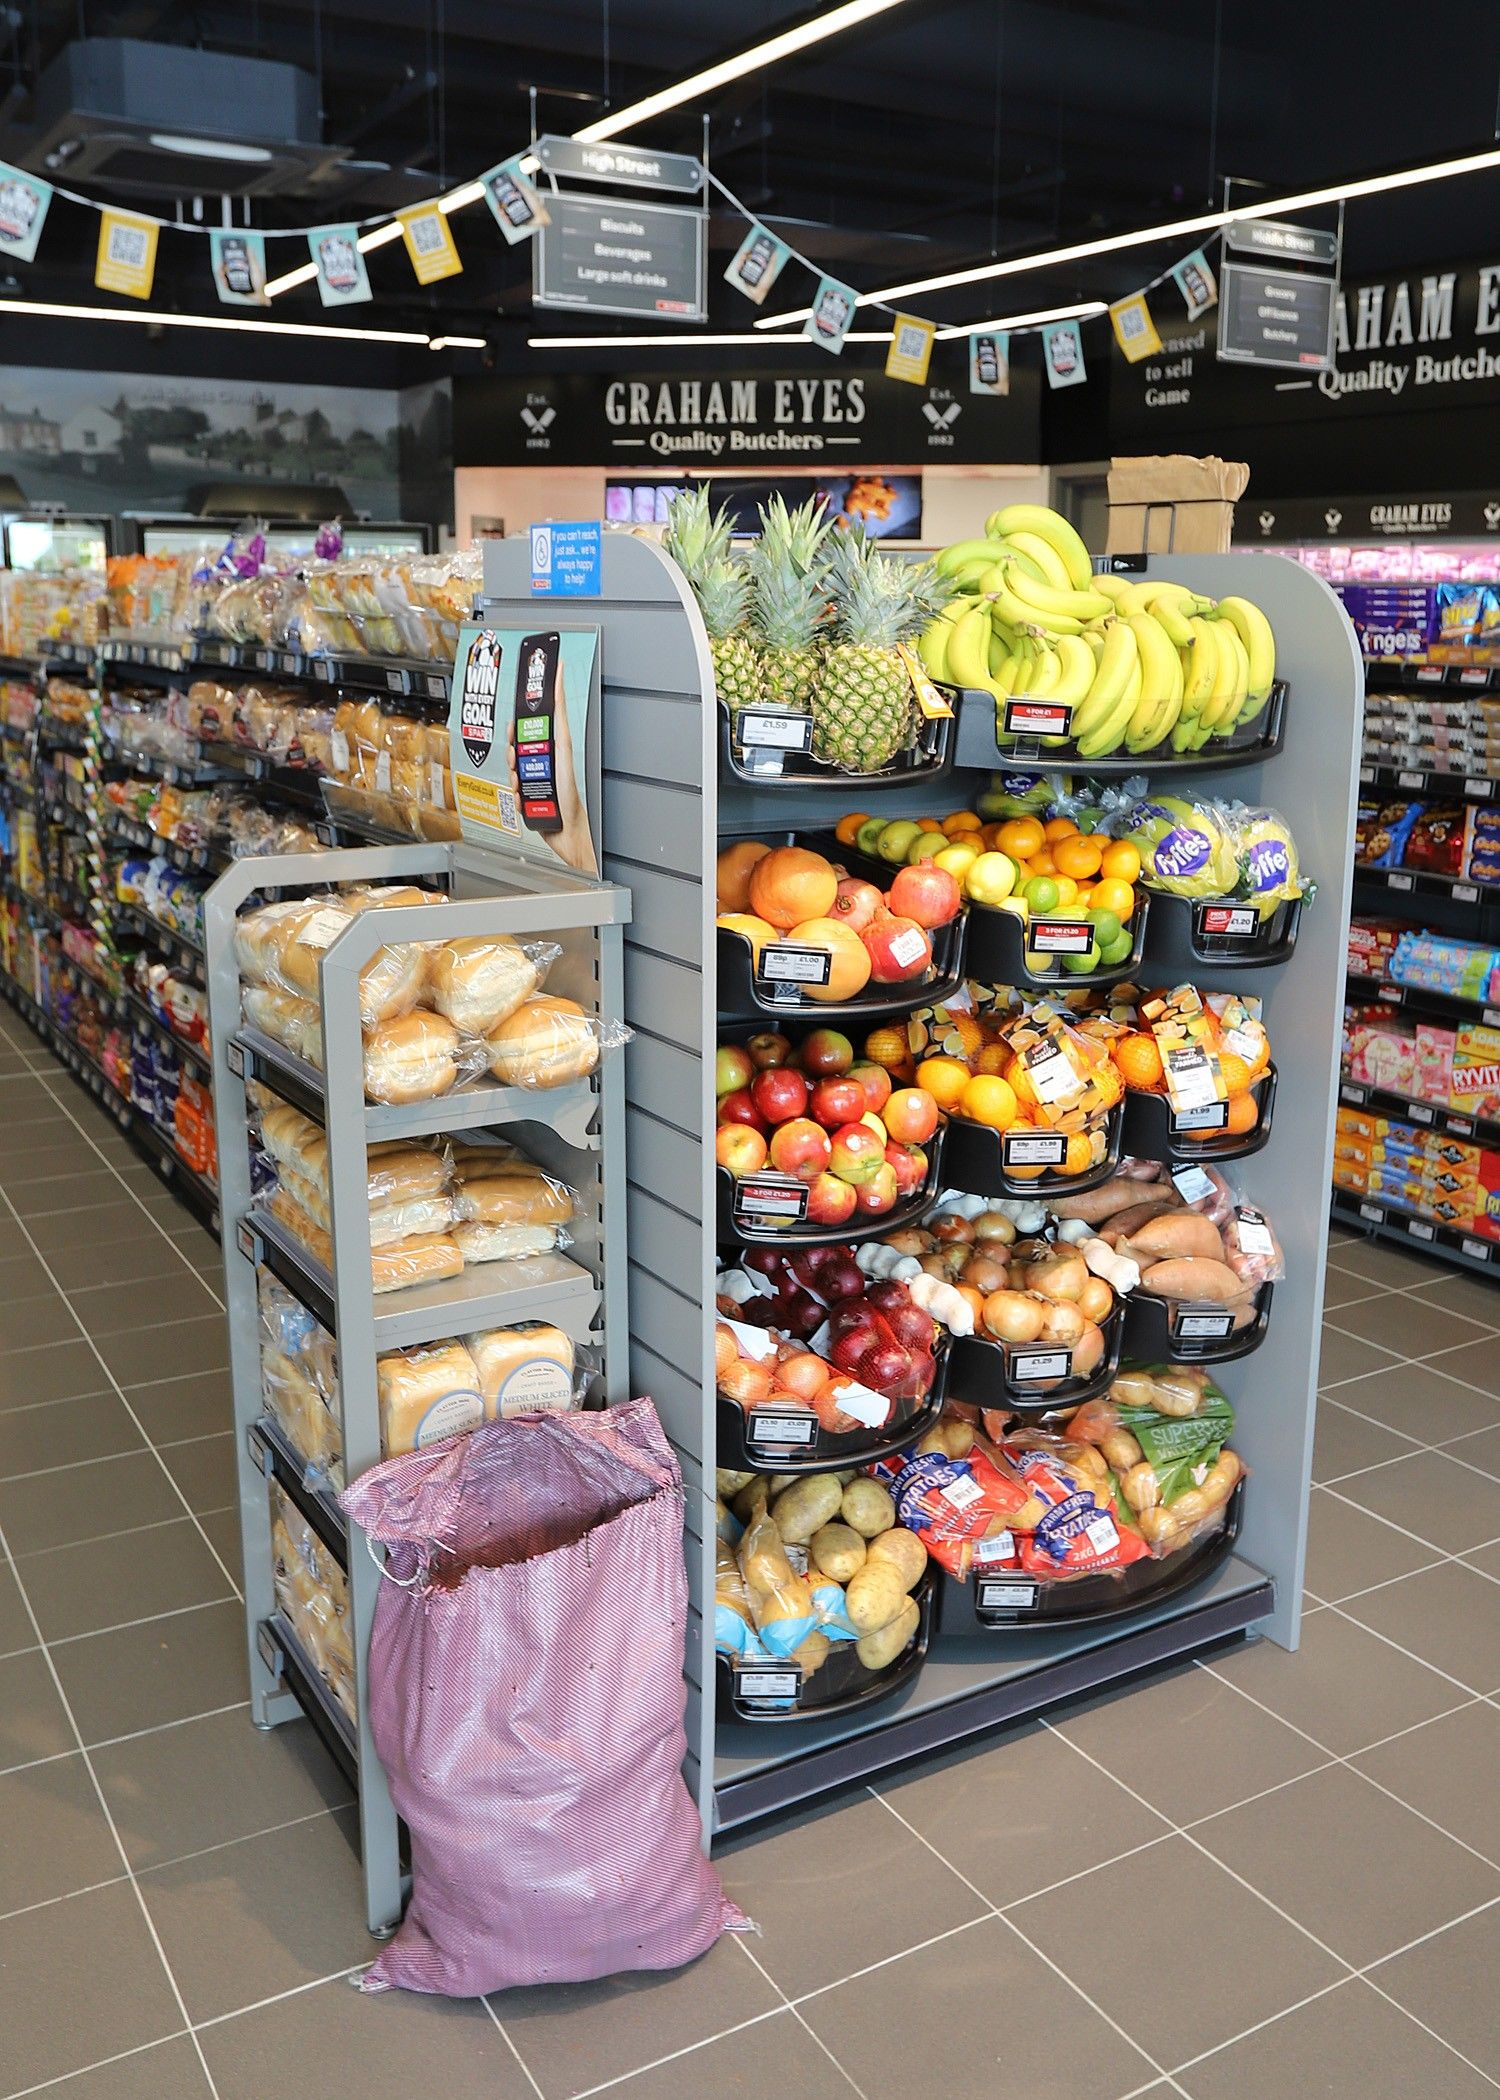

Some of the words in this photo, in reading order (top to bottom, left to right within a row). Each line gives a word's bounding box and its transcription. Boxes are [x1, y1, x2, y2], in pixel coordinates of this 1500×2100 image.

[581, 151, 615, 172] High
[615, 155, 661, 178] Street
[600, 217, 645, 236] Biscuits
[593, 242, 653, 263] Beverages
[1285, 233, 1315, 252] Street
[577, 265, 610, 284] Large
[610, 269, 633, 285] soft
[633, 272, 668, 288] drinks
[1333, 272, 1457, 354] AHAM
[1145, 366, 1163, 382] to
[1165, 357, 1193, 379] sell
[1318, 361, 1410, 400] Quality
[1414, 347, 1500, 385] Butch
[605, 379, 758, 425] GRAHAM
[773, 379, 866, 423] EYES
[930, 388, 956, 400] Est.
[1145, 388, 1191, 407] Game
[650, 430, 726, 456] Quality
[730, 429, 824, 452] Butchers
[1370, 504, 1419, 525] GRAHAM
[1421, 503, 1452, 523] EYES
[467, 665, 499, 695] WIN
[463, 702, 494, 727] GOAL
[762, 720, 788, 730] £1.59
[467, 726, 487, 740] SPAR
[1156, 834, 1210, 875] fyffes
[1248, 848, 1287, 888] yffe
[1063, 927, 1079, 935] £1.20
[1231, 918, 1251, 926] £1.20
[1453, 1064, 1500, 1088] RYVIT
[1190, 1107, 1210, 1115] £1.99
[1031, 1357, 1053, 1365] £1.29
[503, 1393, 540, 1404] MEDIUM
[540, 1390, 570, 1401] SLICED
[457, 1416, 481, 1429] SLICE
[904, 1456, 937, 1479] FRESH
[899, 1465, 958, 1519] OTATOES
[1041, 1507, 1066, 1529] FARM
[1072, 1546, 1095, 1562] 2KG
